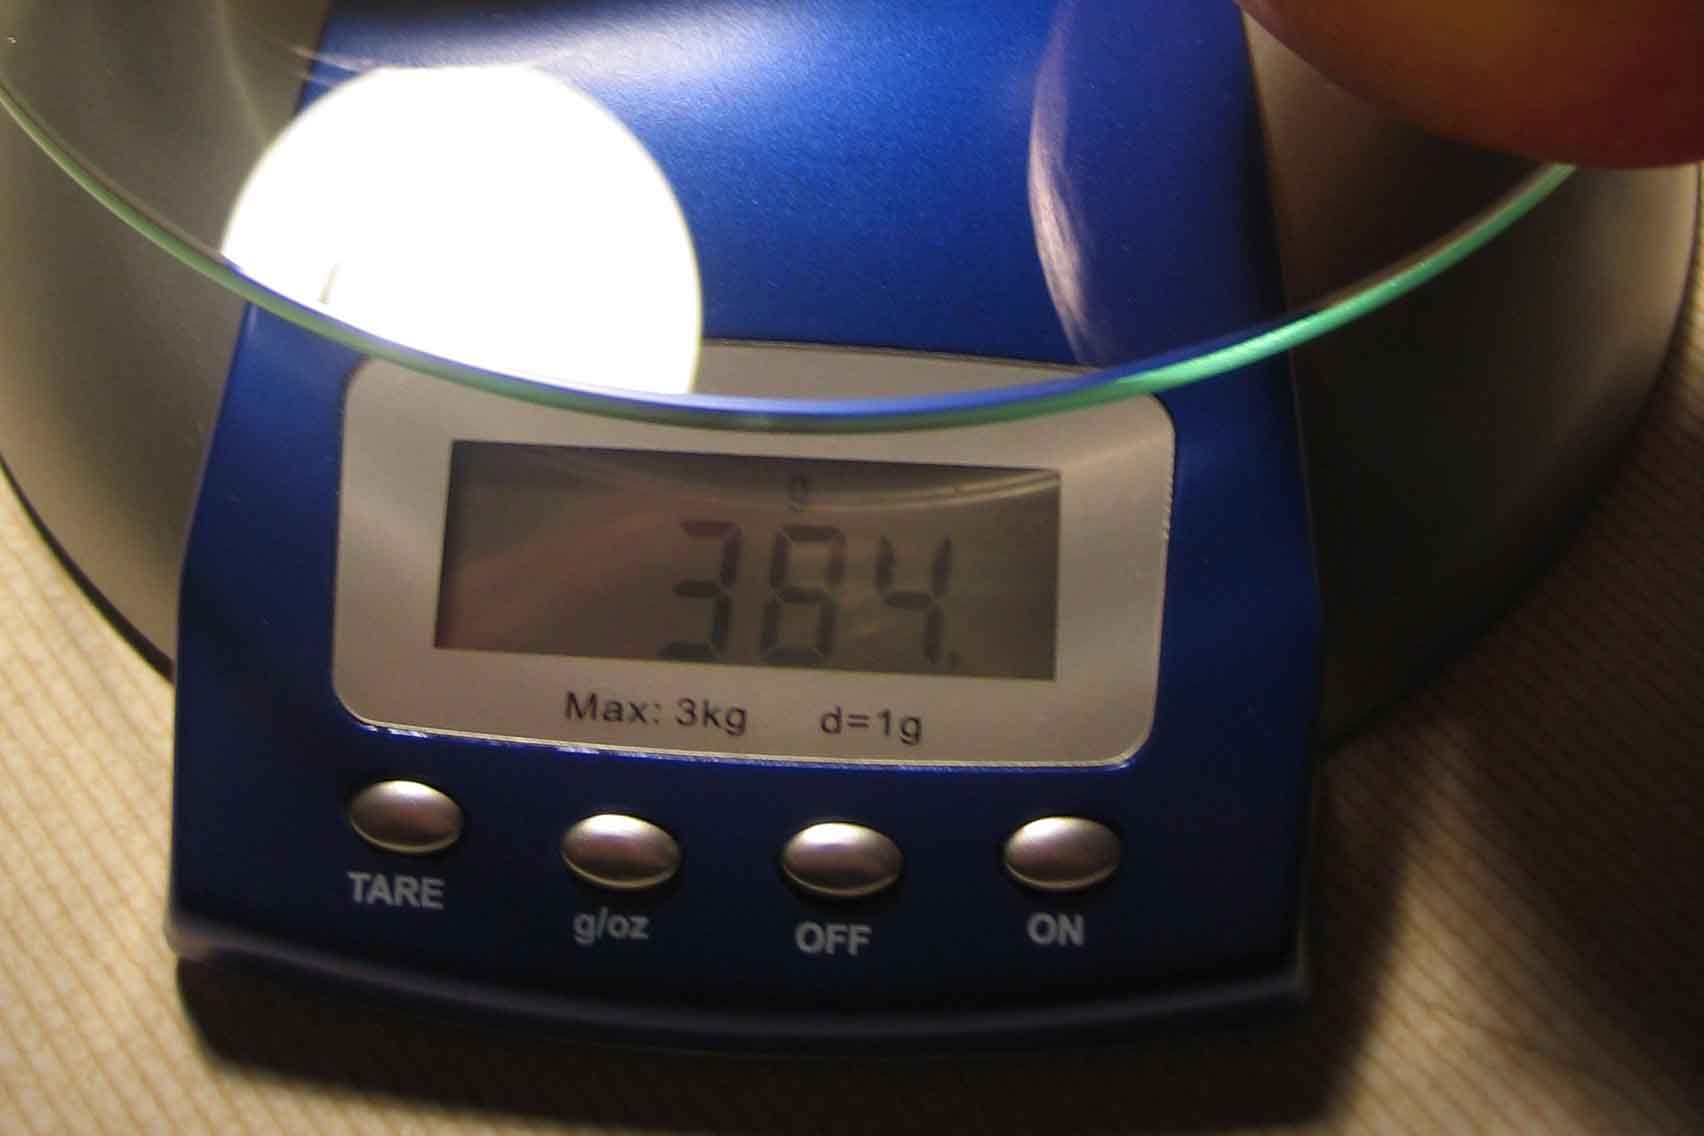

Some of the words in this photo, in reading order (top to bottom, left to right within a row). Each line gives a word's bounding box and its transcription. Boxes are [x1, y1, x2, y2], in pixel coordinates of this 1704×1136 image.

[565, 691, 662, 726] Max:
[676, 697, 747, 737] 3kg
[820, 705, 923, 745] d=1g
[348, 872, 444, 910] TARE
[572, 907, 649, 945] g/oz
[795, 922, 870, 957] OFF
[1027, 913, 1084, 946] ON
